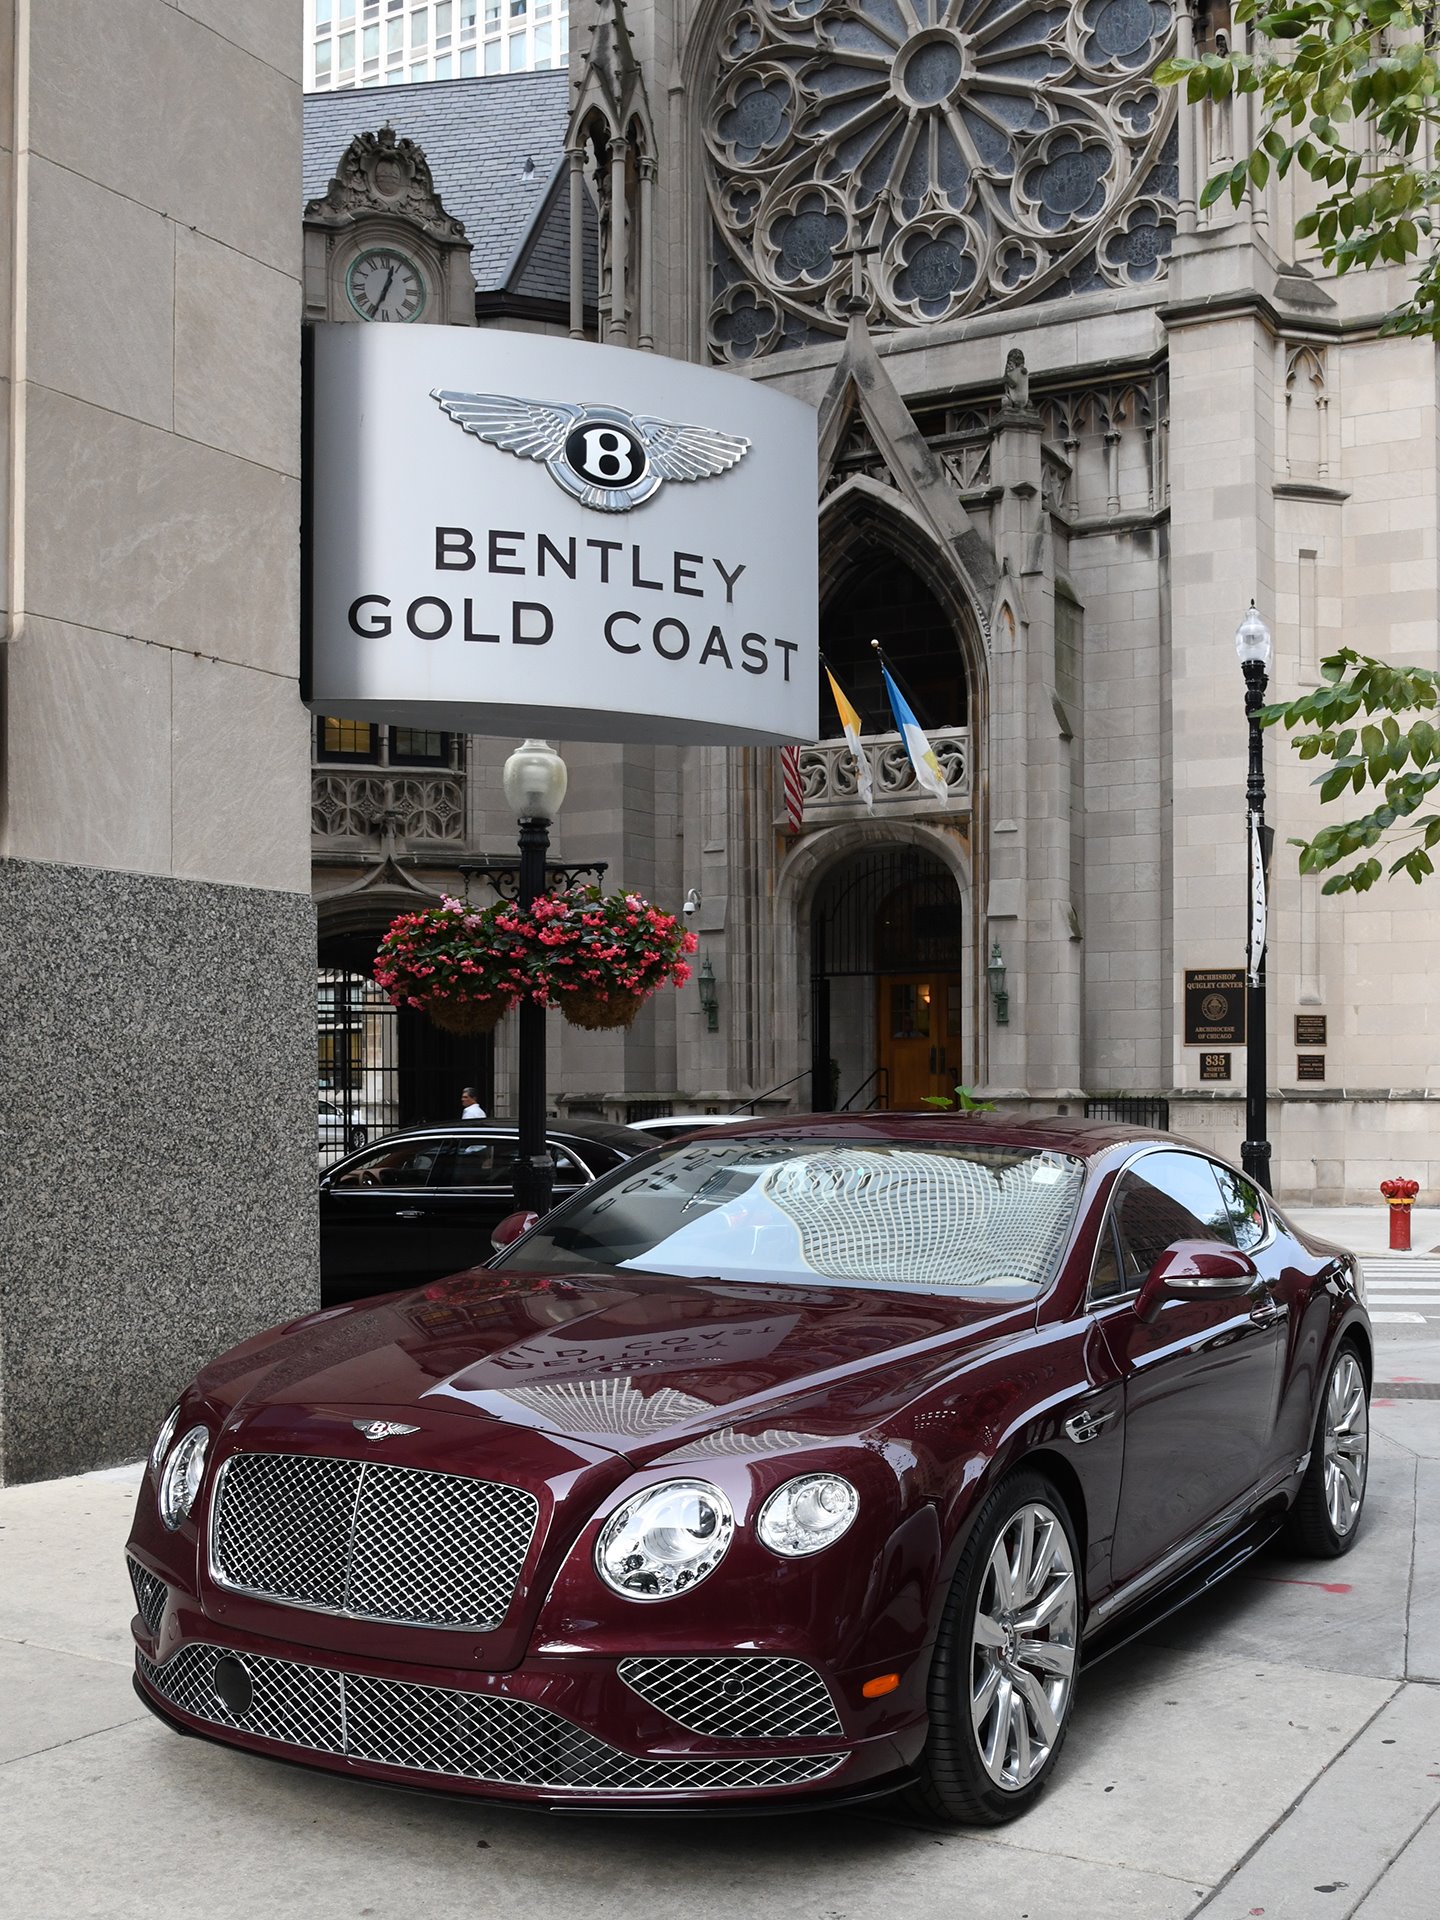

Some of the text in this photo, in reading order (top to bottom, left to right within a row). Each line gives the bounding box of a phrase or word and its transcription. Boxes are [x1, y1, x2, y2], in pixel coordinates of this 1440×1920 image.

[582, 428, 633, 481] B
[435, 526, 747, 604] BENTLEY
[347, 594, 800, 682] GOLD COAST
[1187, 981, 1243, 990] QUIGLEY CENTER
[1205, 1054, 1225, 1066] 835
